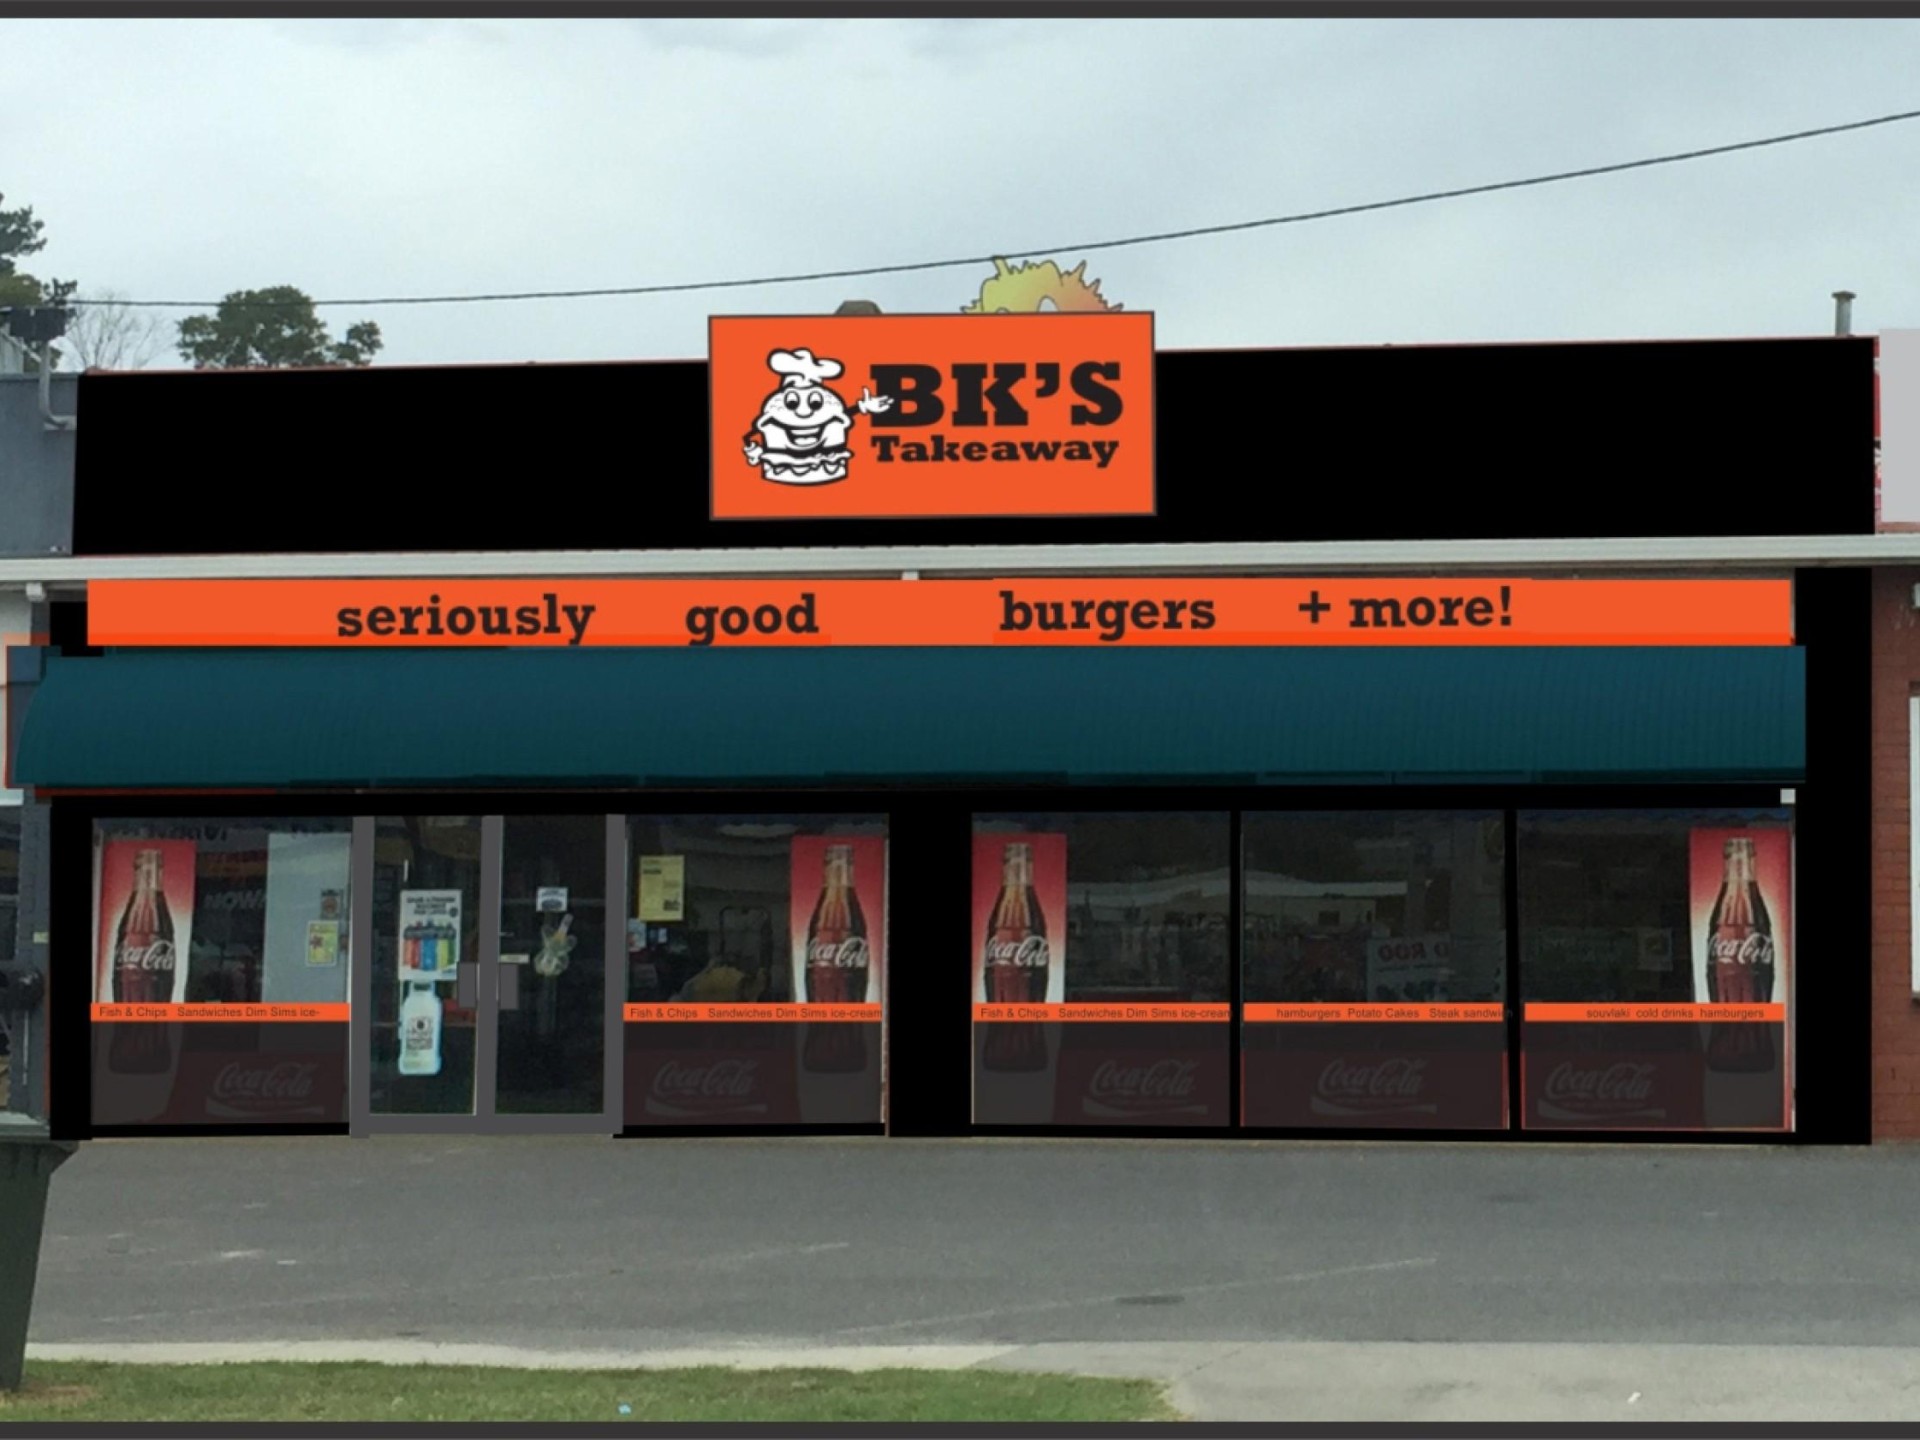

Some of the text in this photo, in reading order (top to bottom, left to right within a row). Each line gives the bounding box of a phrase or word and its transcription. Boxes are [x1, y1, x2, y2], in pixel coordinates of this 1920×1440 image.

[870, 361, 1124, 427] BK'S
[871, 434, 1119, 468] Takeaway
[337, 593, 596, 646] seriously
[685, 593, 819, 646] good
[1000, 591, 1216, 641] burgers
[1350, 586, 1512, 627] more!
[99, 1007, 122, 1017] Fish
[125, 1007, 133, 1017] &
[136, 1007, 167, 1019] Chips
[177, 1007, 242, 1017] Sandwiches
[246, 1007, 267, 1017] Dim
[271, 1007, 297, 1017] Sims
[630, 1008, 652, 1018] Fish
[656, 1008, 664, 1018] &
[667, 1008, 698, 1020] Chips
[708, 1008, 772, 1018] Sandwiches
[776, 1008, 797, 1018] Dim
[800, 1008, 827, 1018] Sims
[981, 1008, 1003, 1018] Fish
[1006, 1008, 1014, 1018] &
[1018, 1008, 1048, 1020] Chips
[1059, 1008, 1122, 1018] Sandwiches
[1126, 1008, 1147, 1018] Dim
[1151, 1008, 1177, 1018] Sims
[1276, 1008, 1340, 1020] hamburgers
[1347, 1008, 1382, 1018] Potato
[1385, 1008, 1419, 1018] Cakes
[1429, 1008, 1459, 1018] Steak
[1586, 1008, 1764, 1020] souvlaki cold drinks hamburgers
